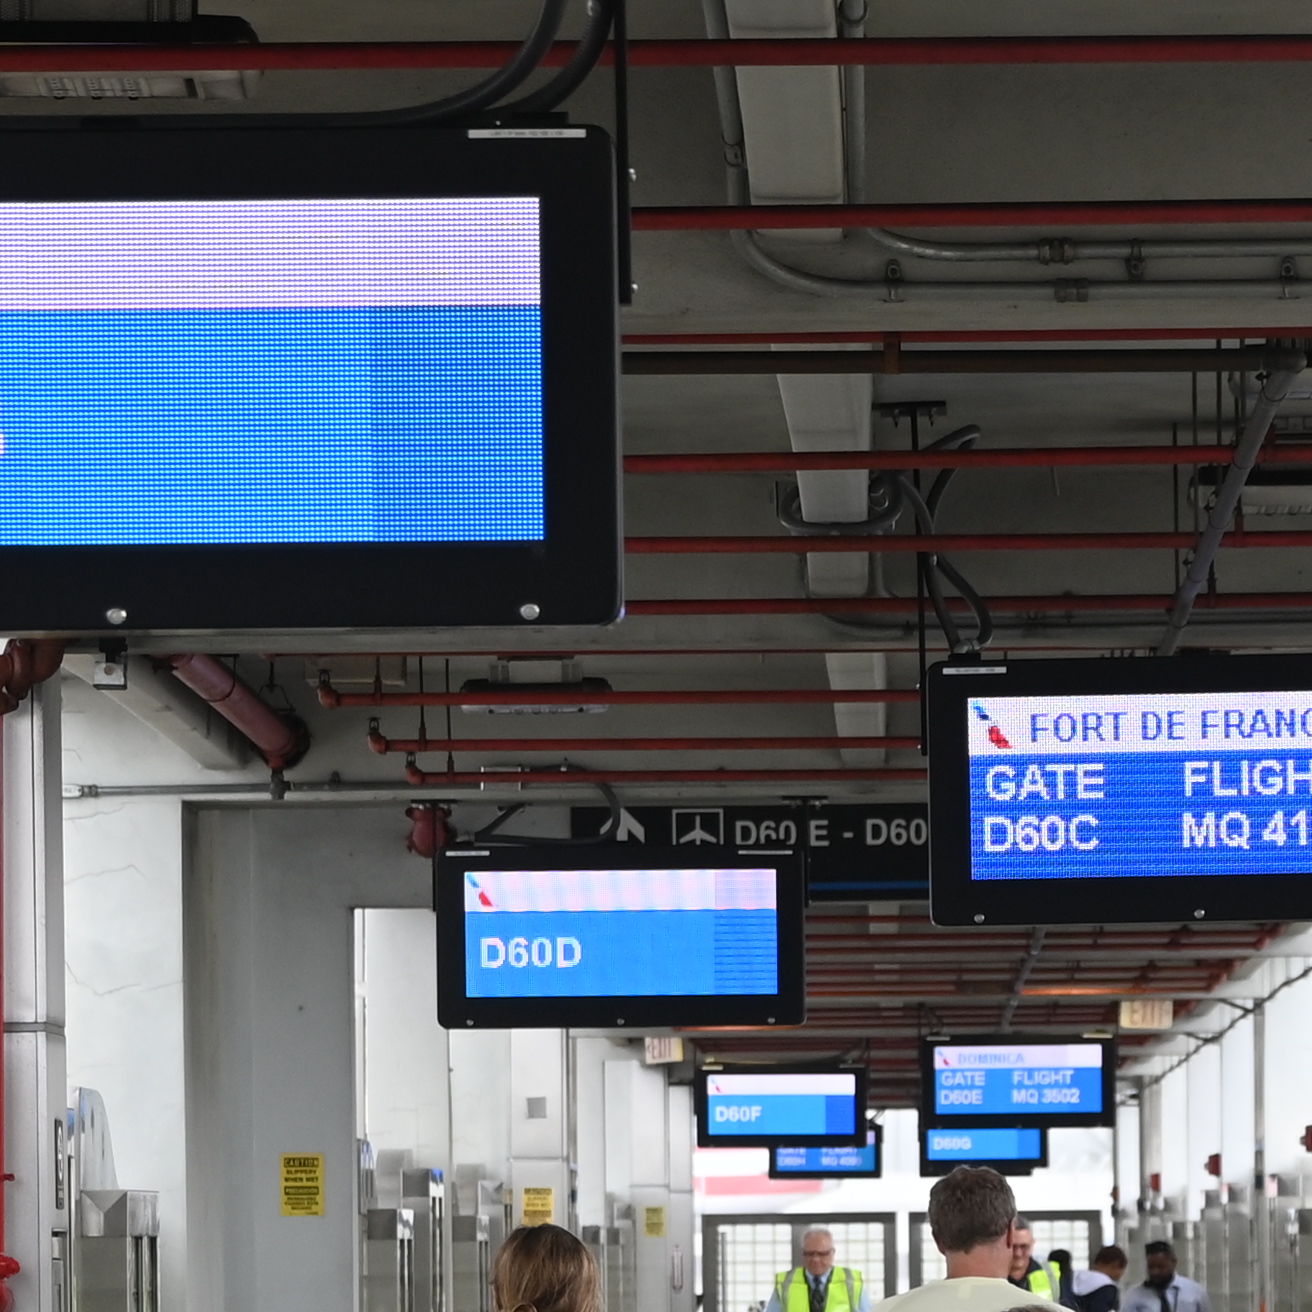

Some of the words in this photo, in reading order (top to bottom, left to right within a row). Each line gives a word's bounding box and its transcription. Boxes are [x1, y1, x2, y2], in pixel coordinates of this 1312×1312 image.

[1030, 711, 1128, 745] FORT
[1140, 710, 1186, 742] DE
[985, 764, 1105, 801] GATE
[982, 816, 1100, 852] D60C
[1182, 812, 1250, 850] MQ
[480, 937, 581, 969] D60D
[958, 1053, 1025, 1065] DOMINICA
[941, 1071, 986, 1086] GATE
[1013, 1070, 1075, 1085] FLIGHT
[1013, 1089, 1039, 1104] MQ
[1042, 1088, 1081, 1103] 3502
[715, 1106, 761, 1122] D60F
